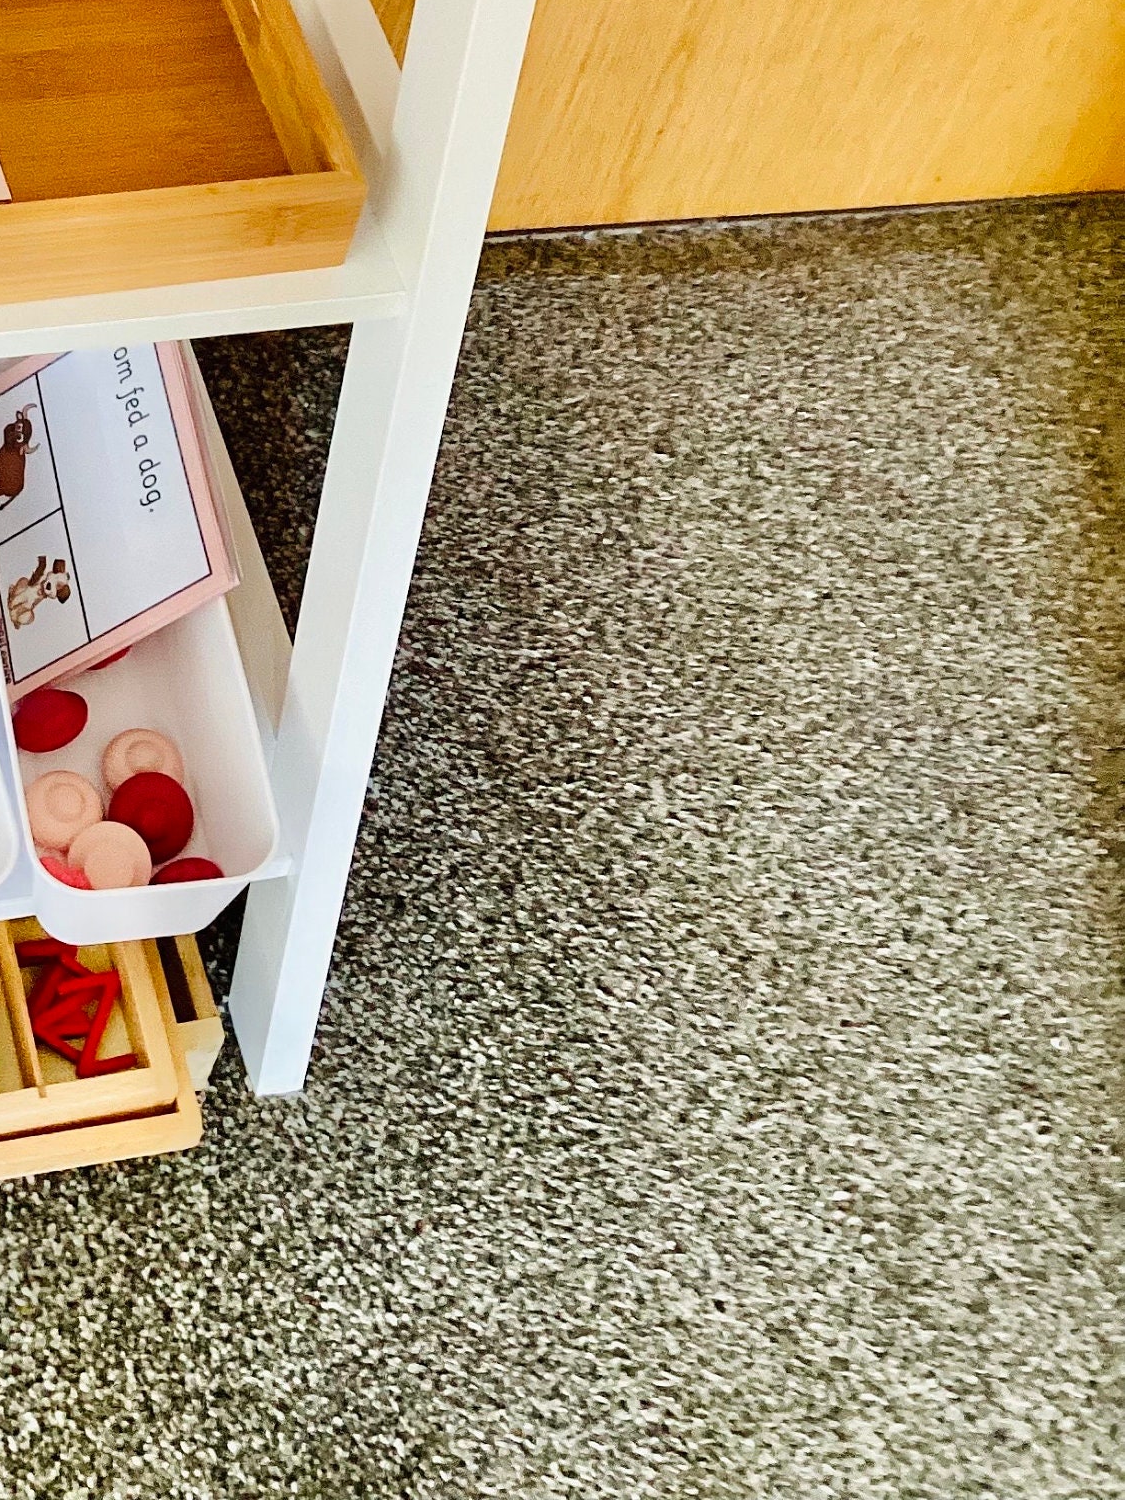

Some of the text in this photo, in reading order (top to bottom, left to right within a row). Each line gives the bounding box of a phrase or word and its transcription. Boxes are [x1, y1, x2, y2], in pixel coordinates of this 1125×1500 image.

[114, 346, 162, 513] om fed a dog.
